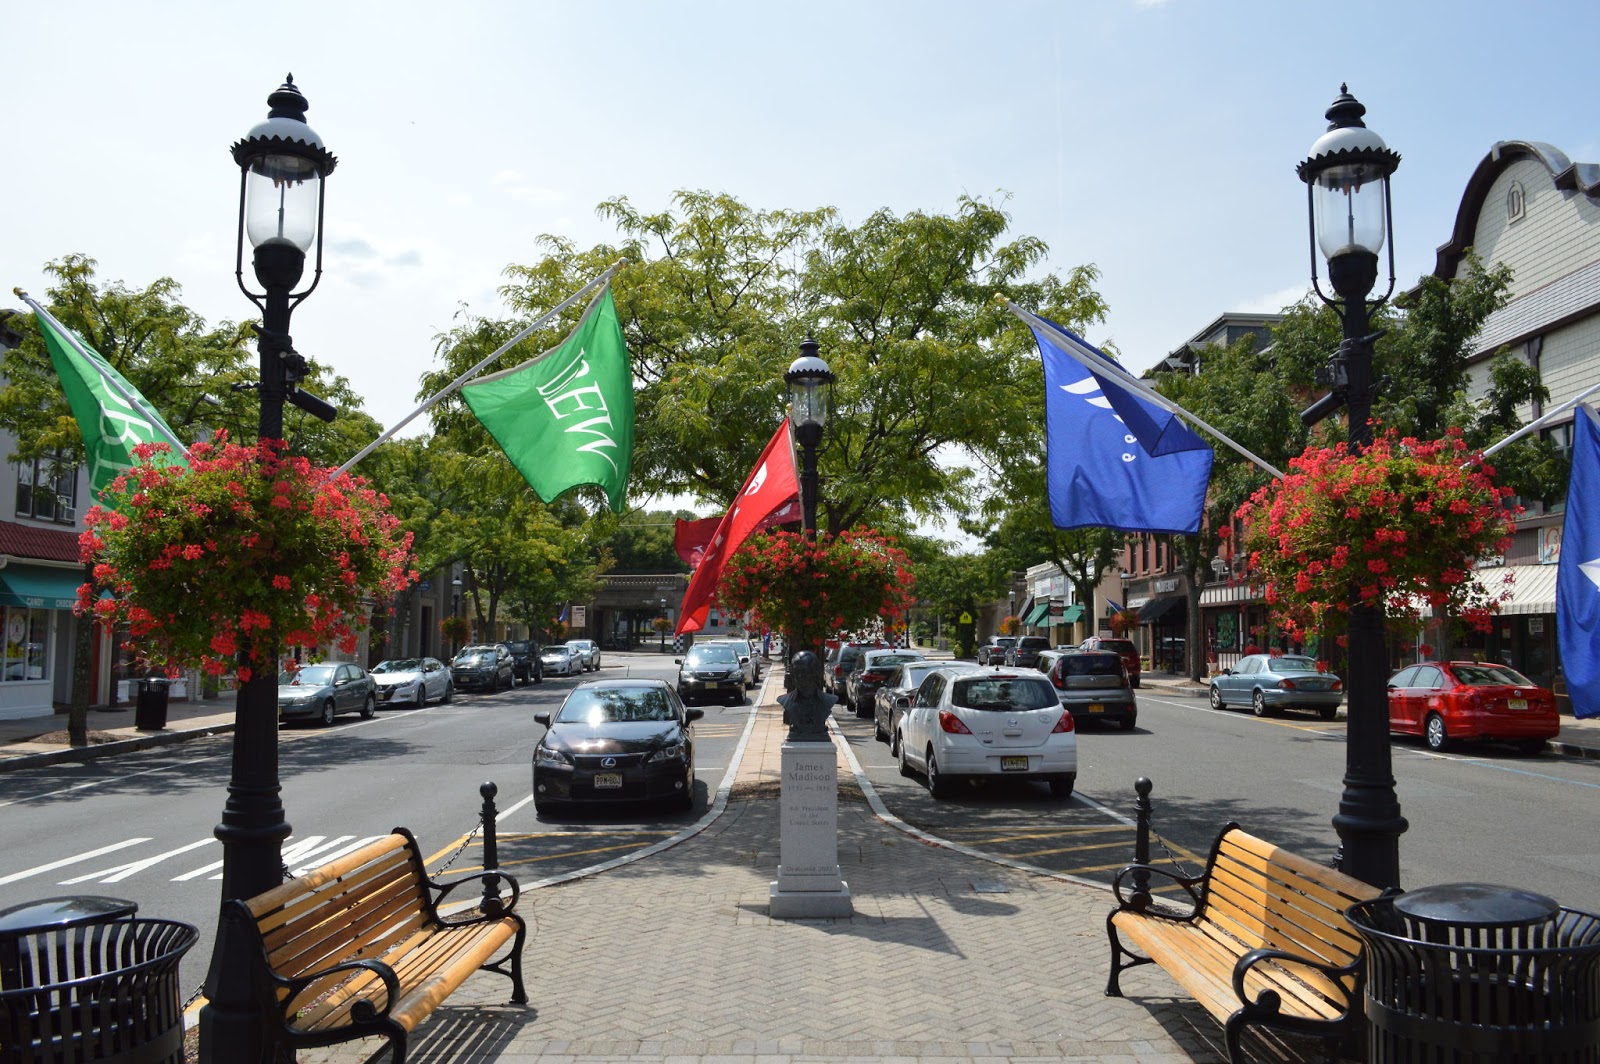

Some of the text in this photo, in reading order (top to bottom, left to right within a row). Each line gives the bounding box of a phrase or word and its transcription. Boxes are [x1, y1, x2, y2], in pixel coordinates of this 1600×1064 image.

[56, 599, 74, 608] CHOCO
[794, 762, 824, 771] James
[788, 772, 831, 781] Madison
